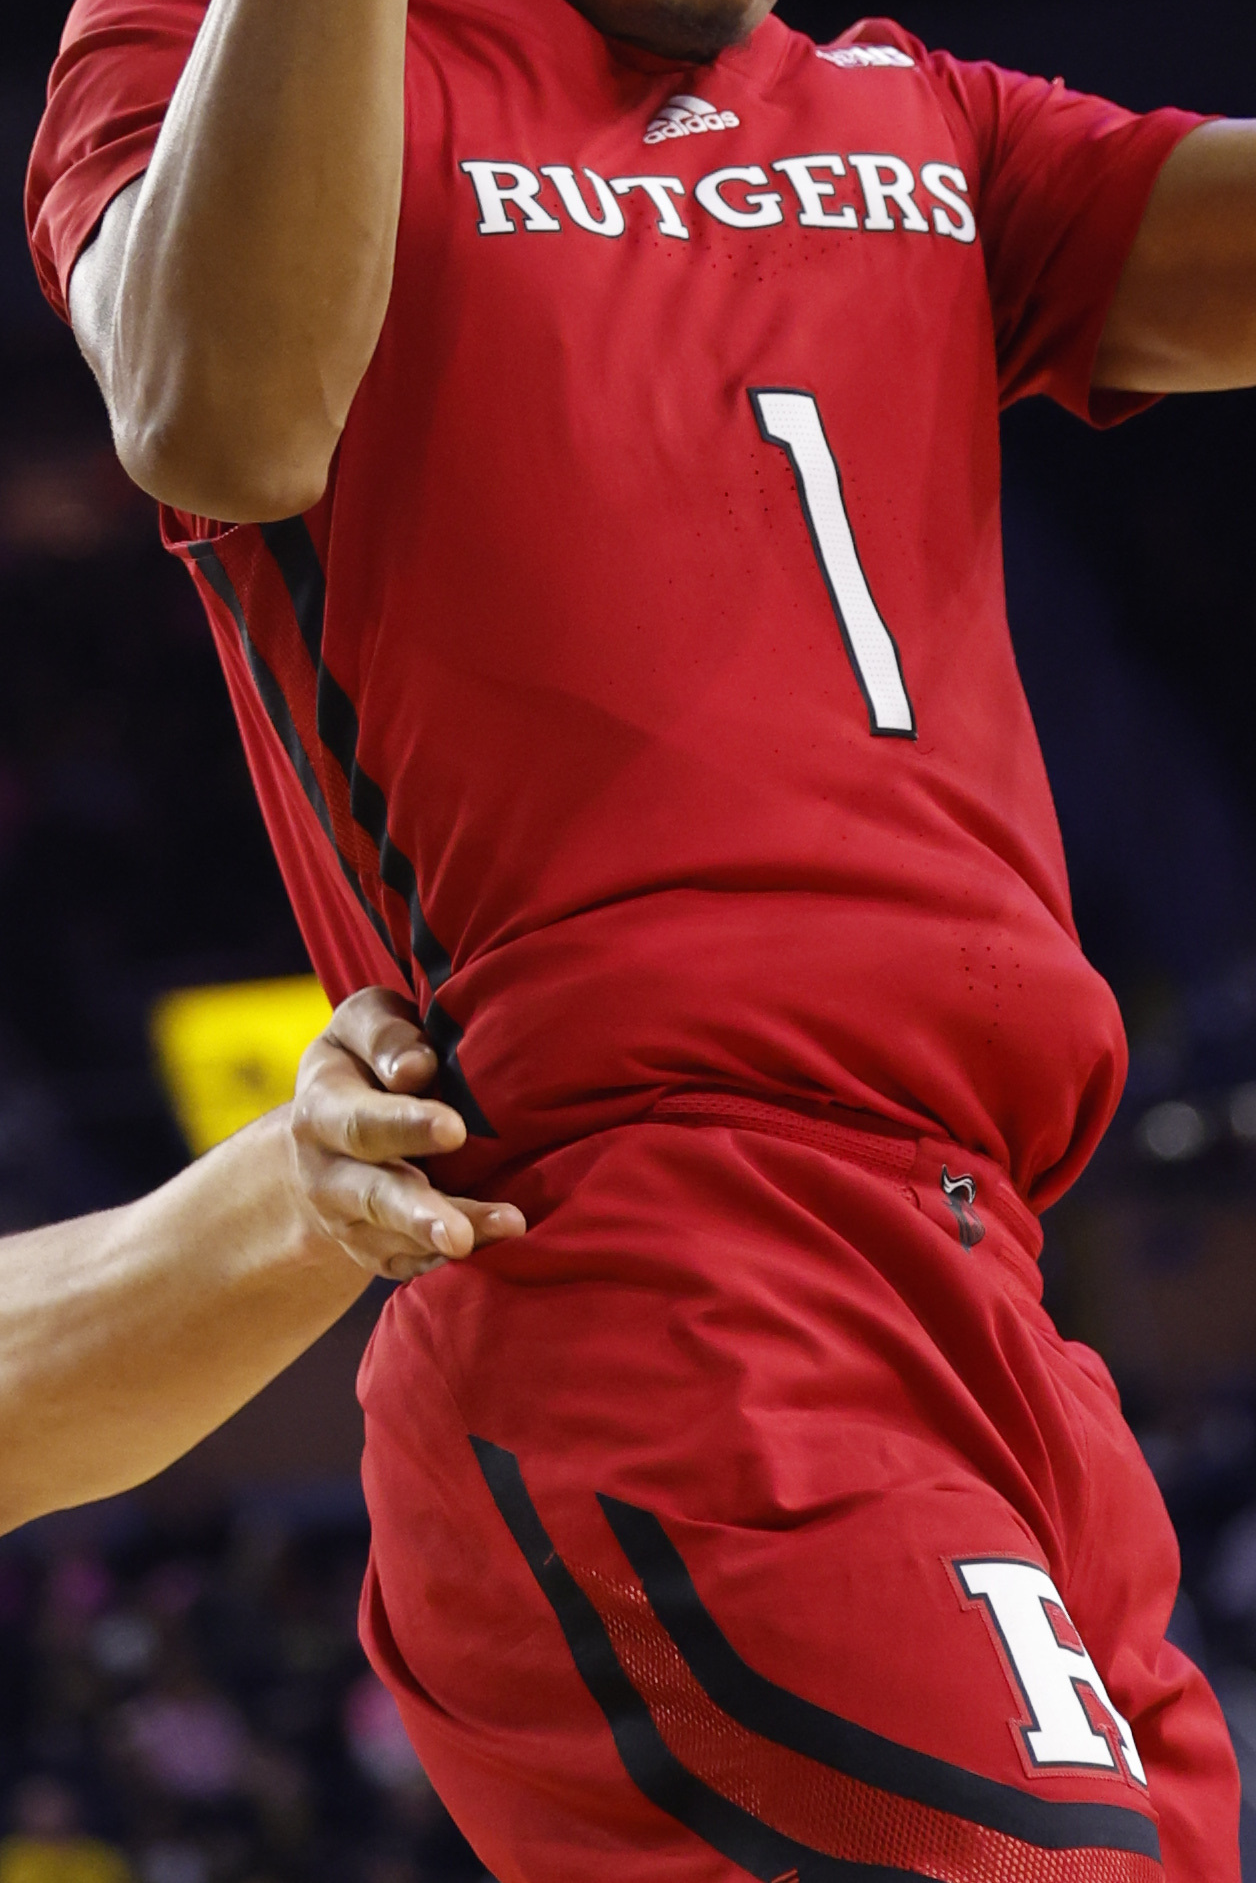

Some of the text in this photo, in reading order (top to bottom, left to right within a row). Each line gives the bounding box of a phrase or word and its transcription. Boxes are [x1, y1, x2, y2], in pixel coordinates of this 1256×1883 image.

[643, 107, 740, 145] adidas
[460, 153, 977, 243] RUTGERS
[751, 389, 915, 735] 1
